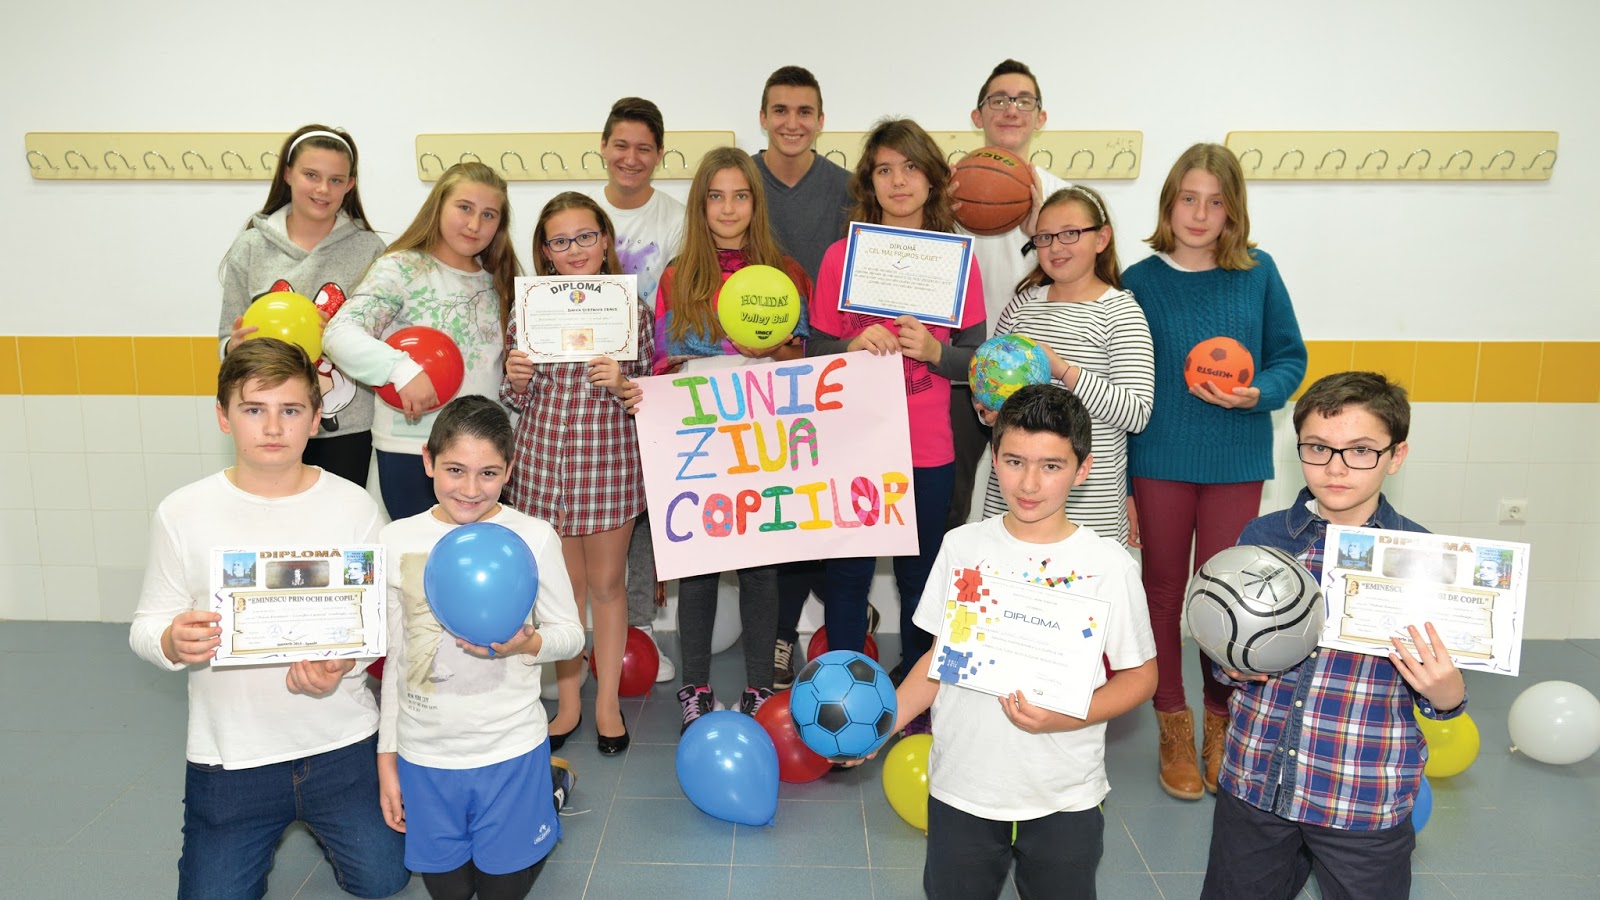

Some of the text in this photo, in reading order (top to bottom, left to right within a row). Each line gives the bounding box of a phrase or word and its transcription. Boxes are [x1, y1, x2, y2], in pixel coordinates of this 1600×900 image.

[894, 251, 919, 260] FRUMOS
[741, 294, 789, 307] HOLIDAY
[740, 312, 789, 325] Volley Ball
[672, 358, 847, 425] IUNIE
[675, 418, 818, 480] ZIUA
[666, 472, 909, 542] COPIILOR
[260, 549, 342, 559] DIPLOMĂ
[1448, 594, 1459, 602] DE
[1003, 610, 1061, 630] DIPLOMA
